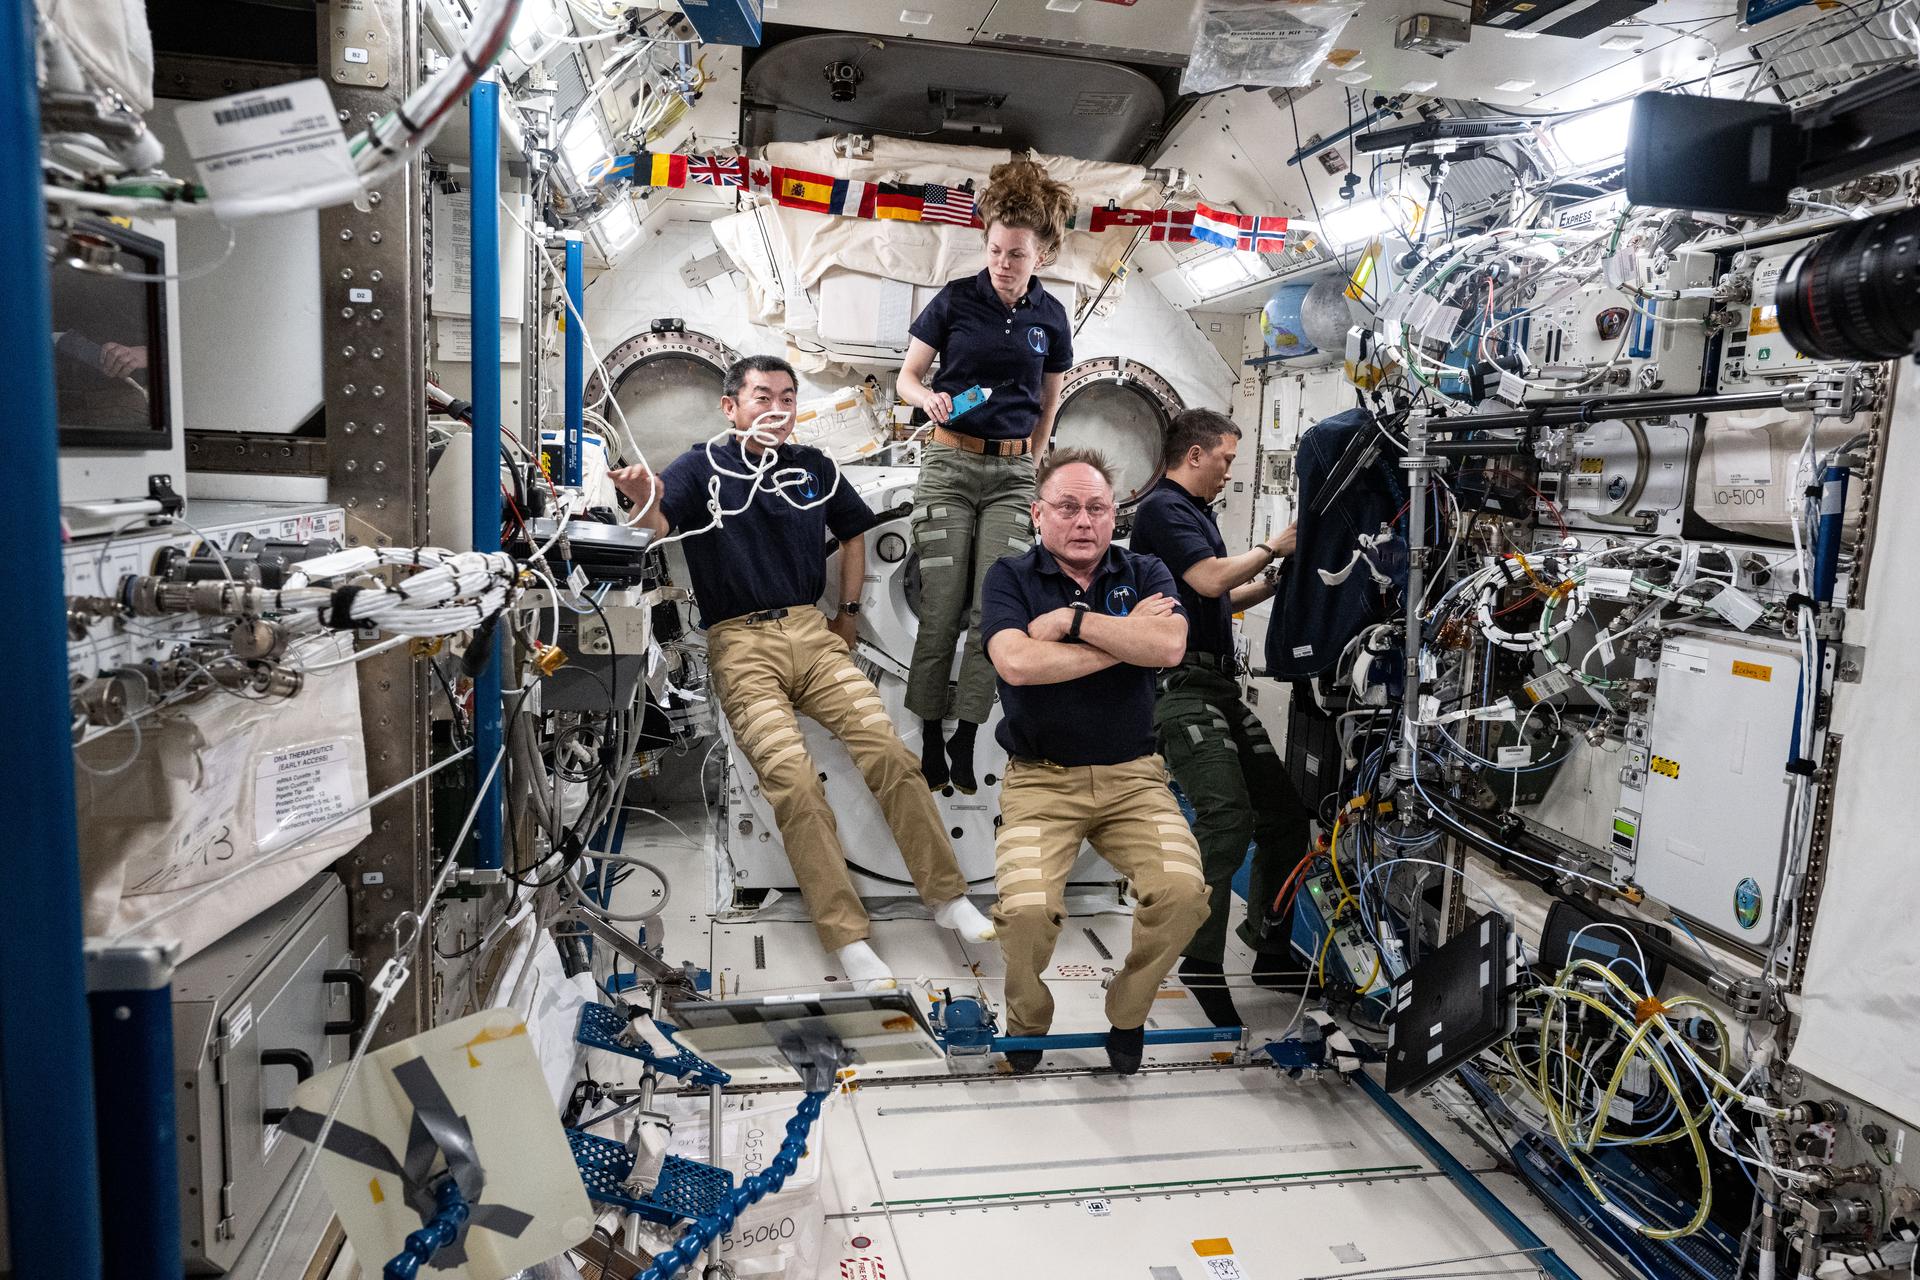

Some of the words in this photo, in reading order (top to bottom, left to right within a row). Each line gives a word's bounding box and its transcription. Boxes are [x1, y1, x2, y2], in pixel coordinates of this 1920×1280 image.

[273, 755, 287, 763] DNA
[289, 745, 334, 760] THERAPEUTICS
[278, 761, 301, 772] (EARLY
[302, 755, 329, 766] ACCESS)
[294, 789, 302, 797] Tip
